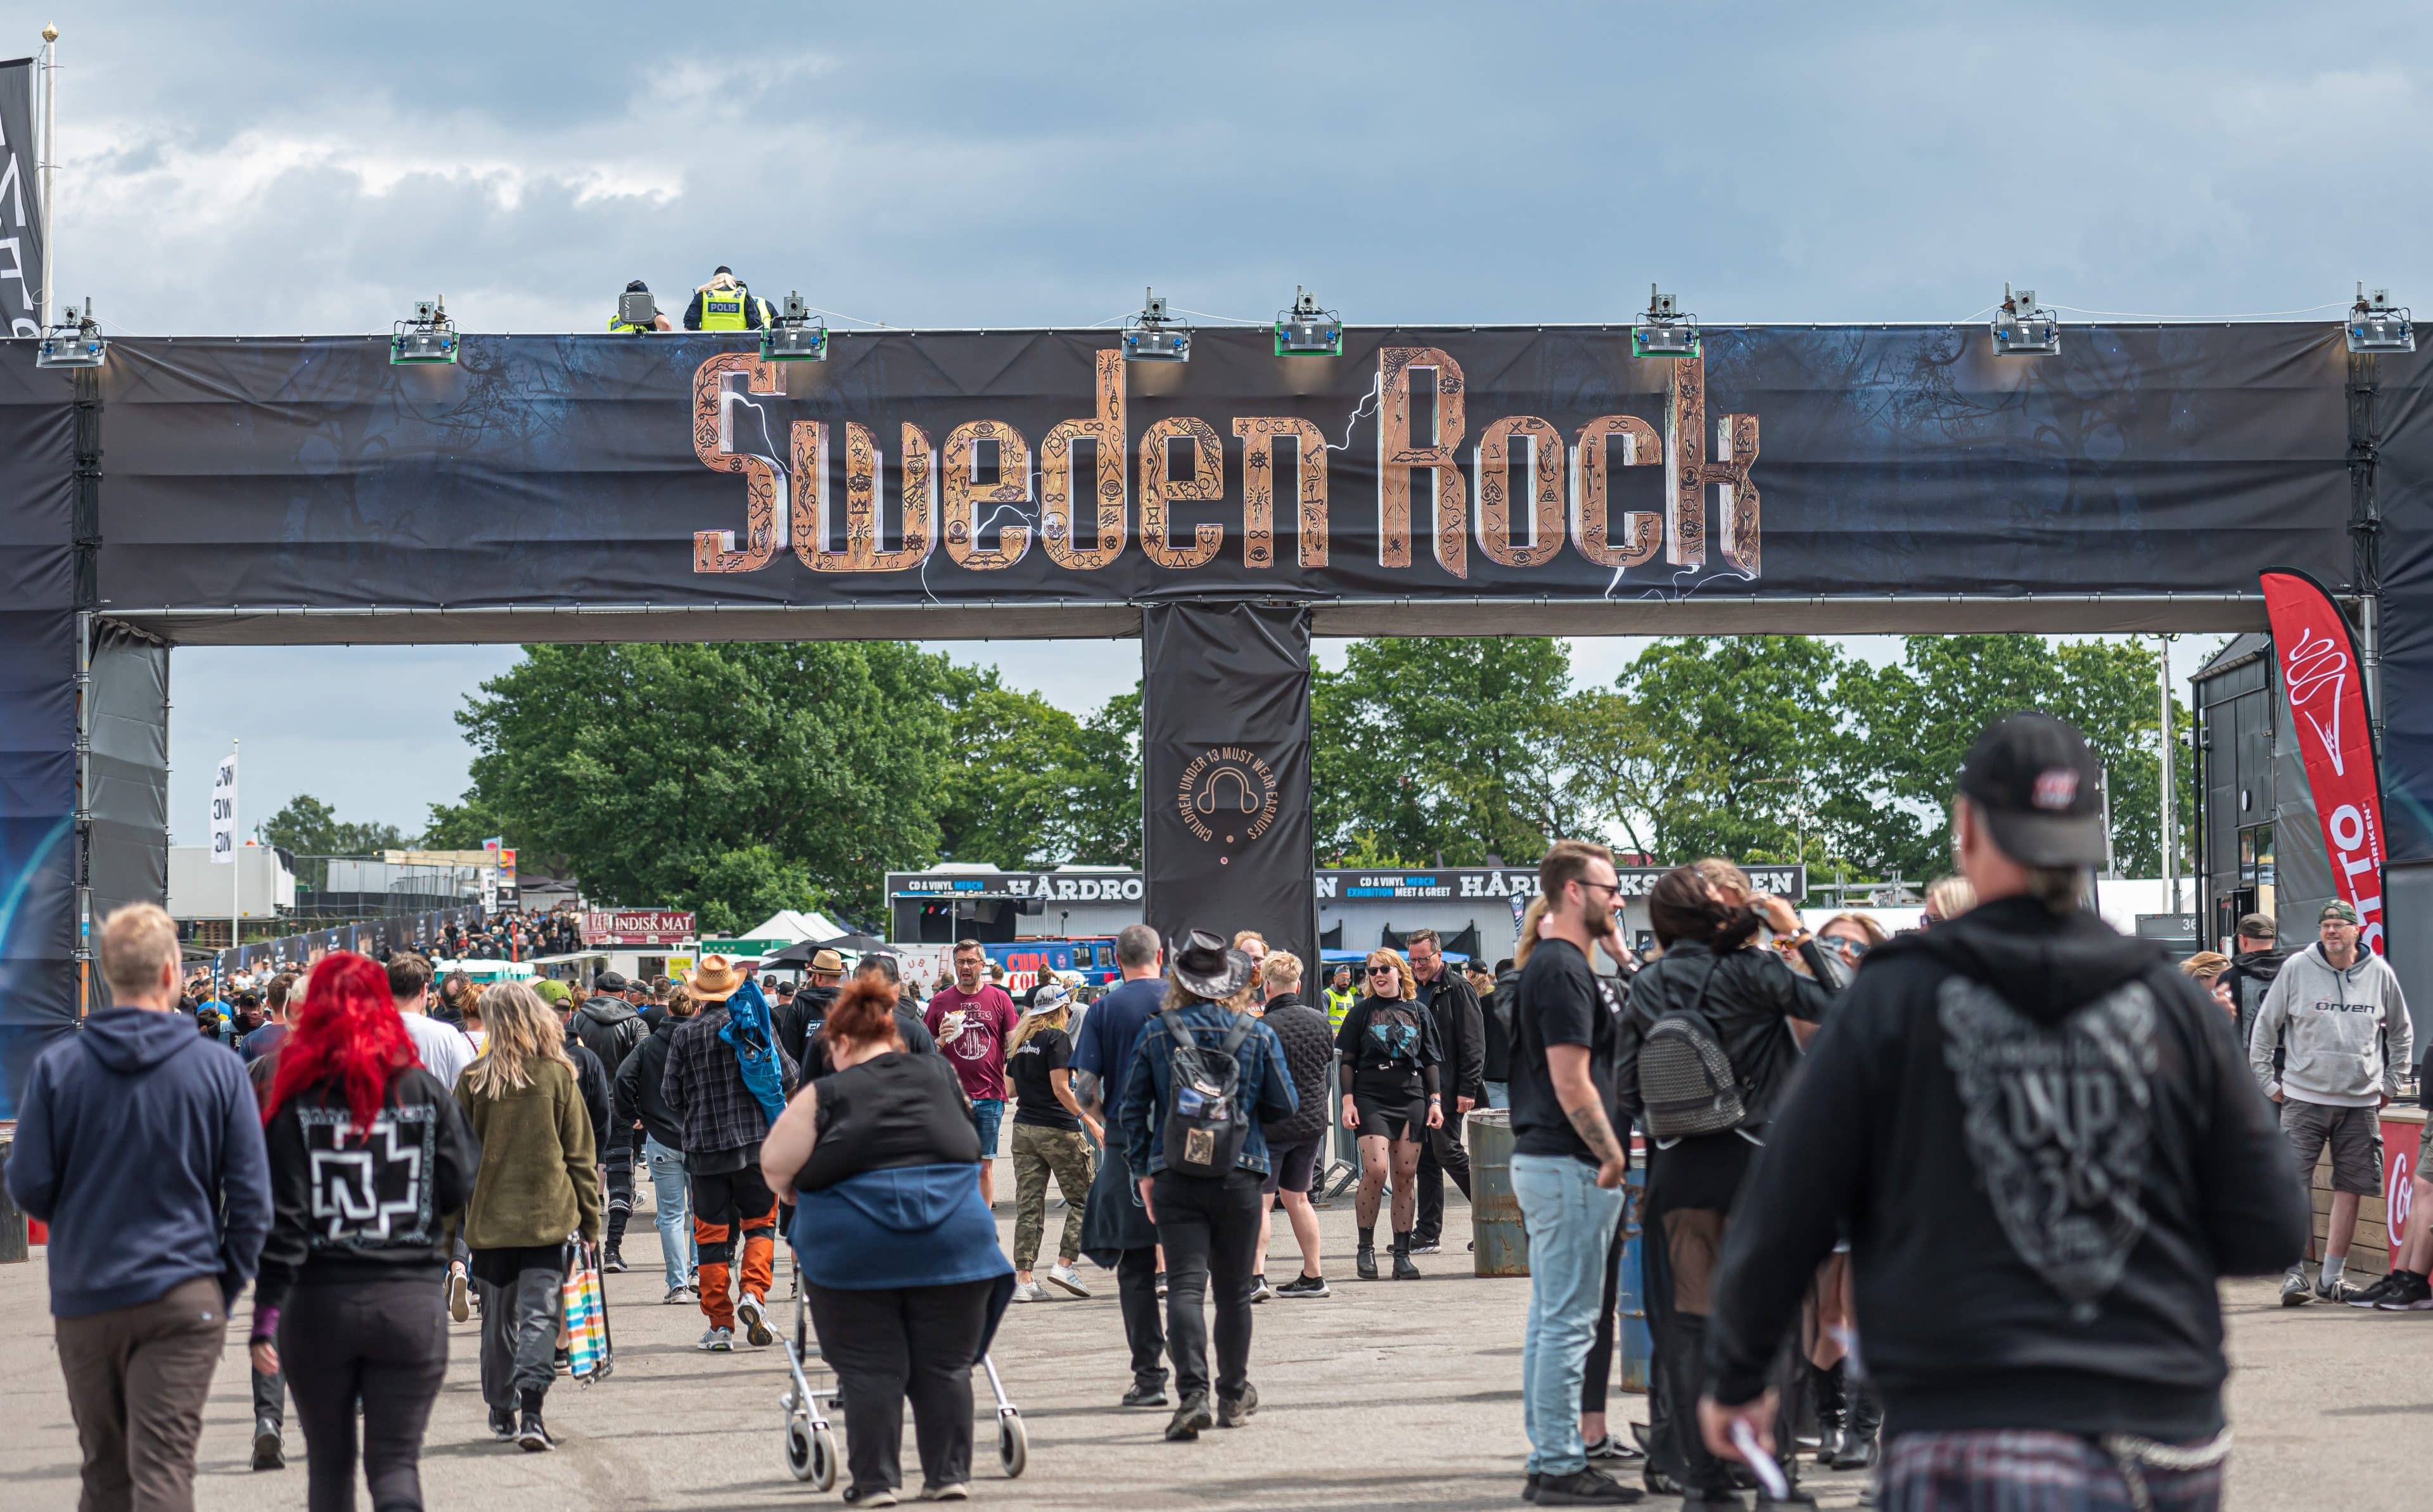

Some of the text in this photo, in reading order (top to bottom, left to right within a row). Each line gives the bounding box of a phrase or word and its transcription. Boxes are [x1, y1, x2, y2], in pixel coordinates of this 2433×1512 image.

[710, 303, 738, 312] POLIS
[694, 346, 1761, 579] Sweden Rock
[1206, 749, 1220, 763] 13
[1222, 747, 1254, 764] MUST
[1179, 756, 1207, 791] UNDER
[1252, 758, 1276, 789] WEAR
[1178, 794, 1213, 842] CHILDREN
[909, 880, 983, 891] CD & VINYL MERCH
[1360, 877, 1436, 887] CD & VINYL MERCH
[1346, 887, 1451, 898] EXHIBITION MEET & GREET
[615, 917, 691, 931] INDISK MAT
[1006, 953, 1049, 972] CUBA
